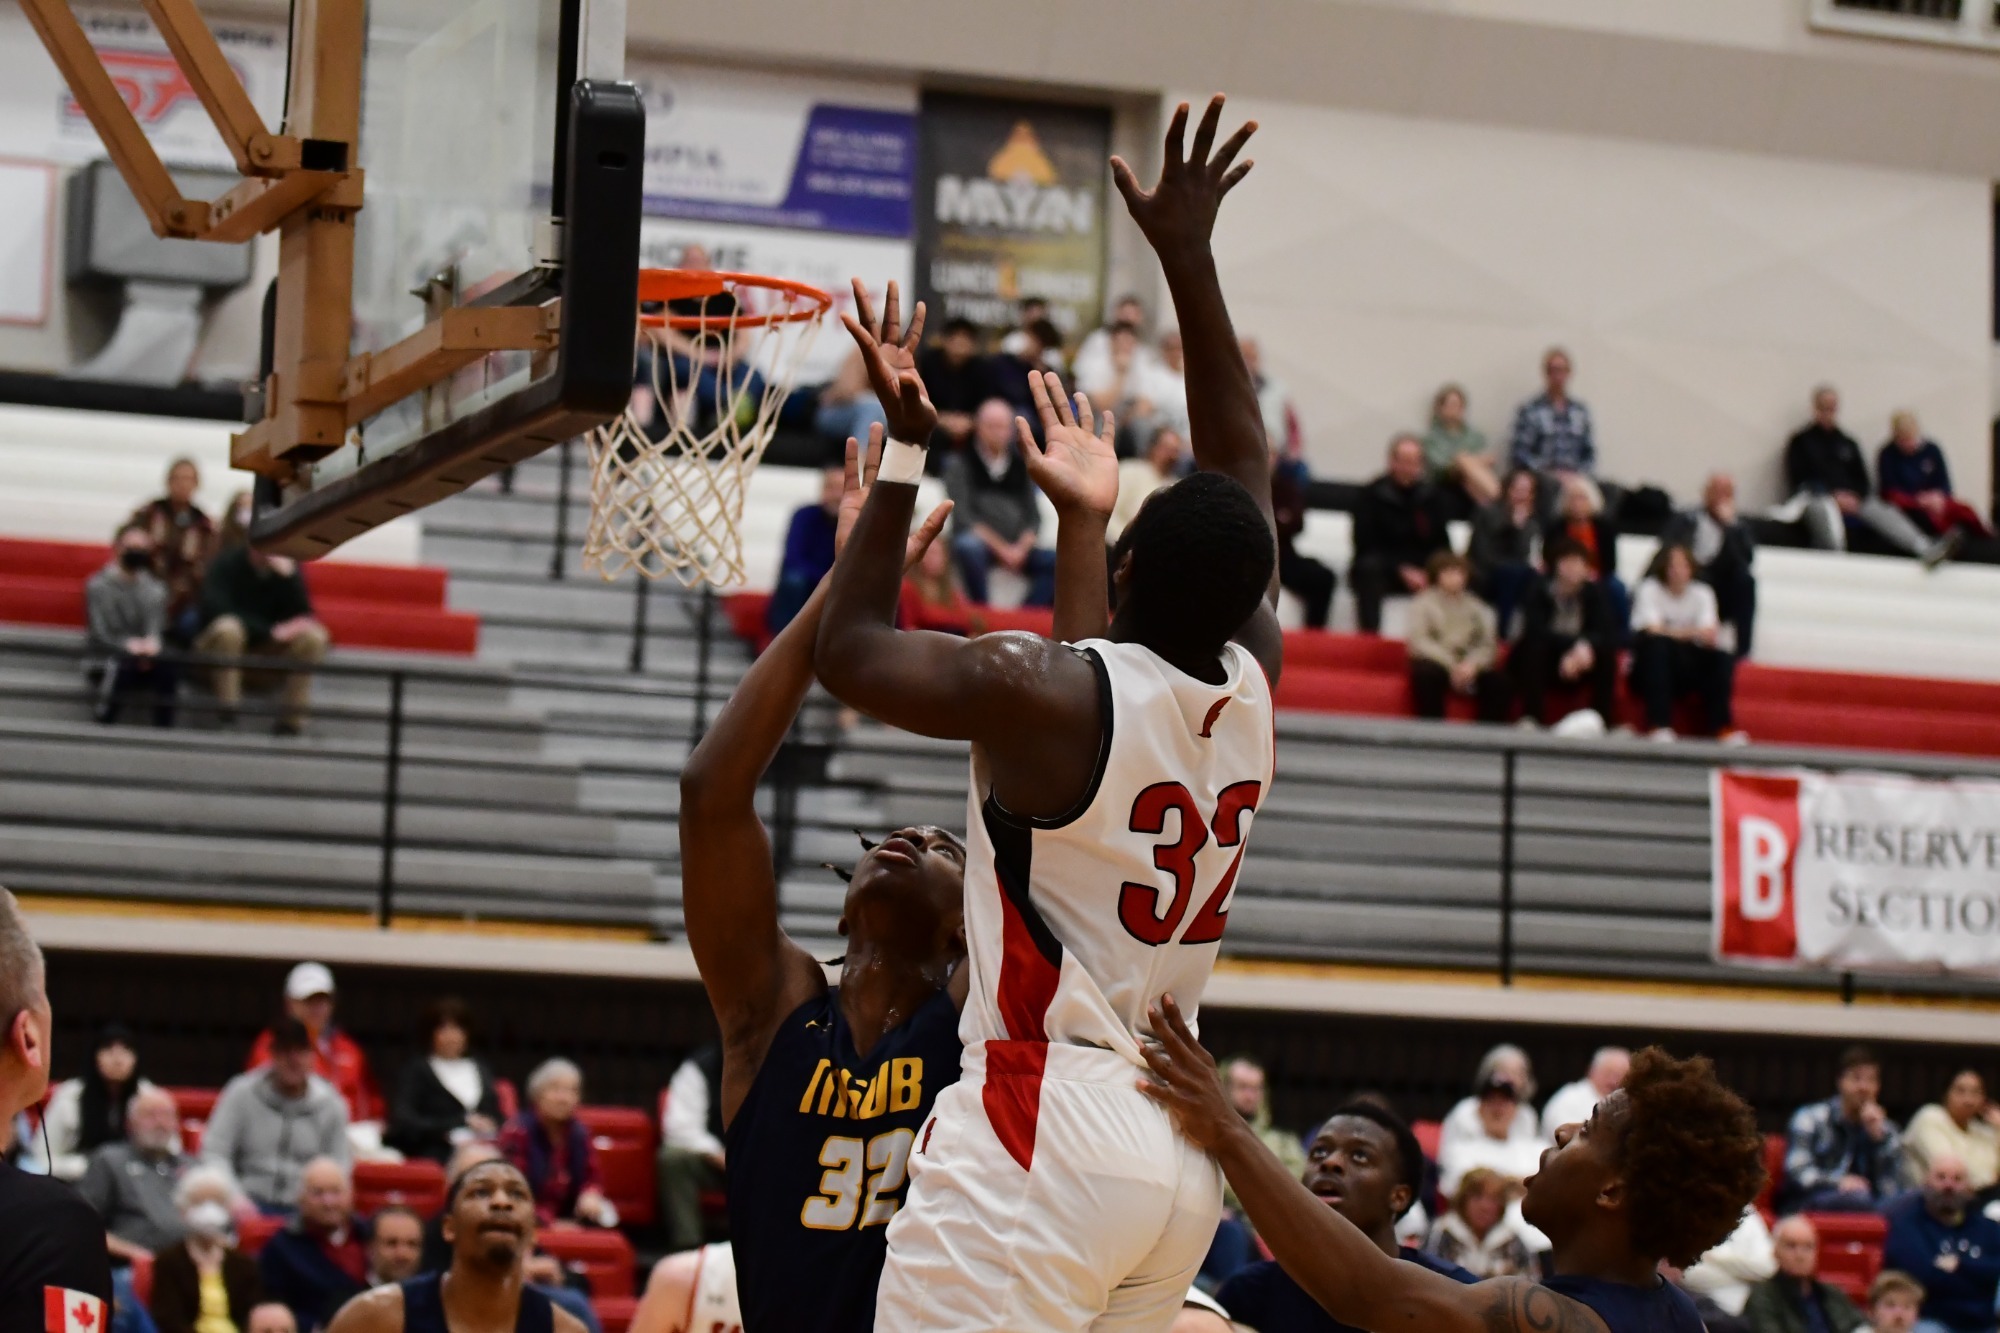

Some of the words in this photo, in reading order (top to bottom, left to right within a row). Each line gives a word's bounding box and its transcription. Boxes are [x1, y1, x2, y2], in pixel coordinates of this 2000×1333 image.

[935, 175, 1094, 233] MAYAN
[1118, 780, 1262, 947] 32
[1738, 813, 1787, 921] B
[1826, 882, 2000, 936] SECTIO
[799, 1057, 923, 1120] MSUB
[800, 1128, 915, 1231] 32
